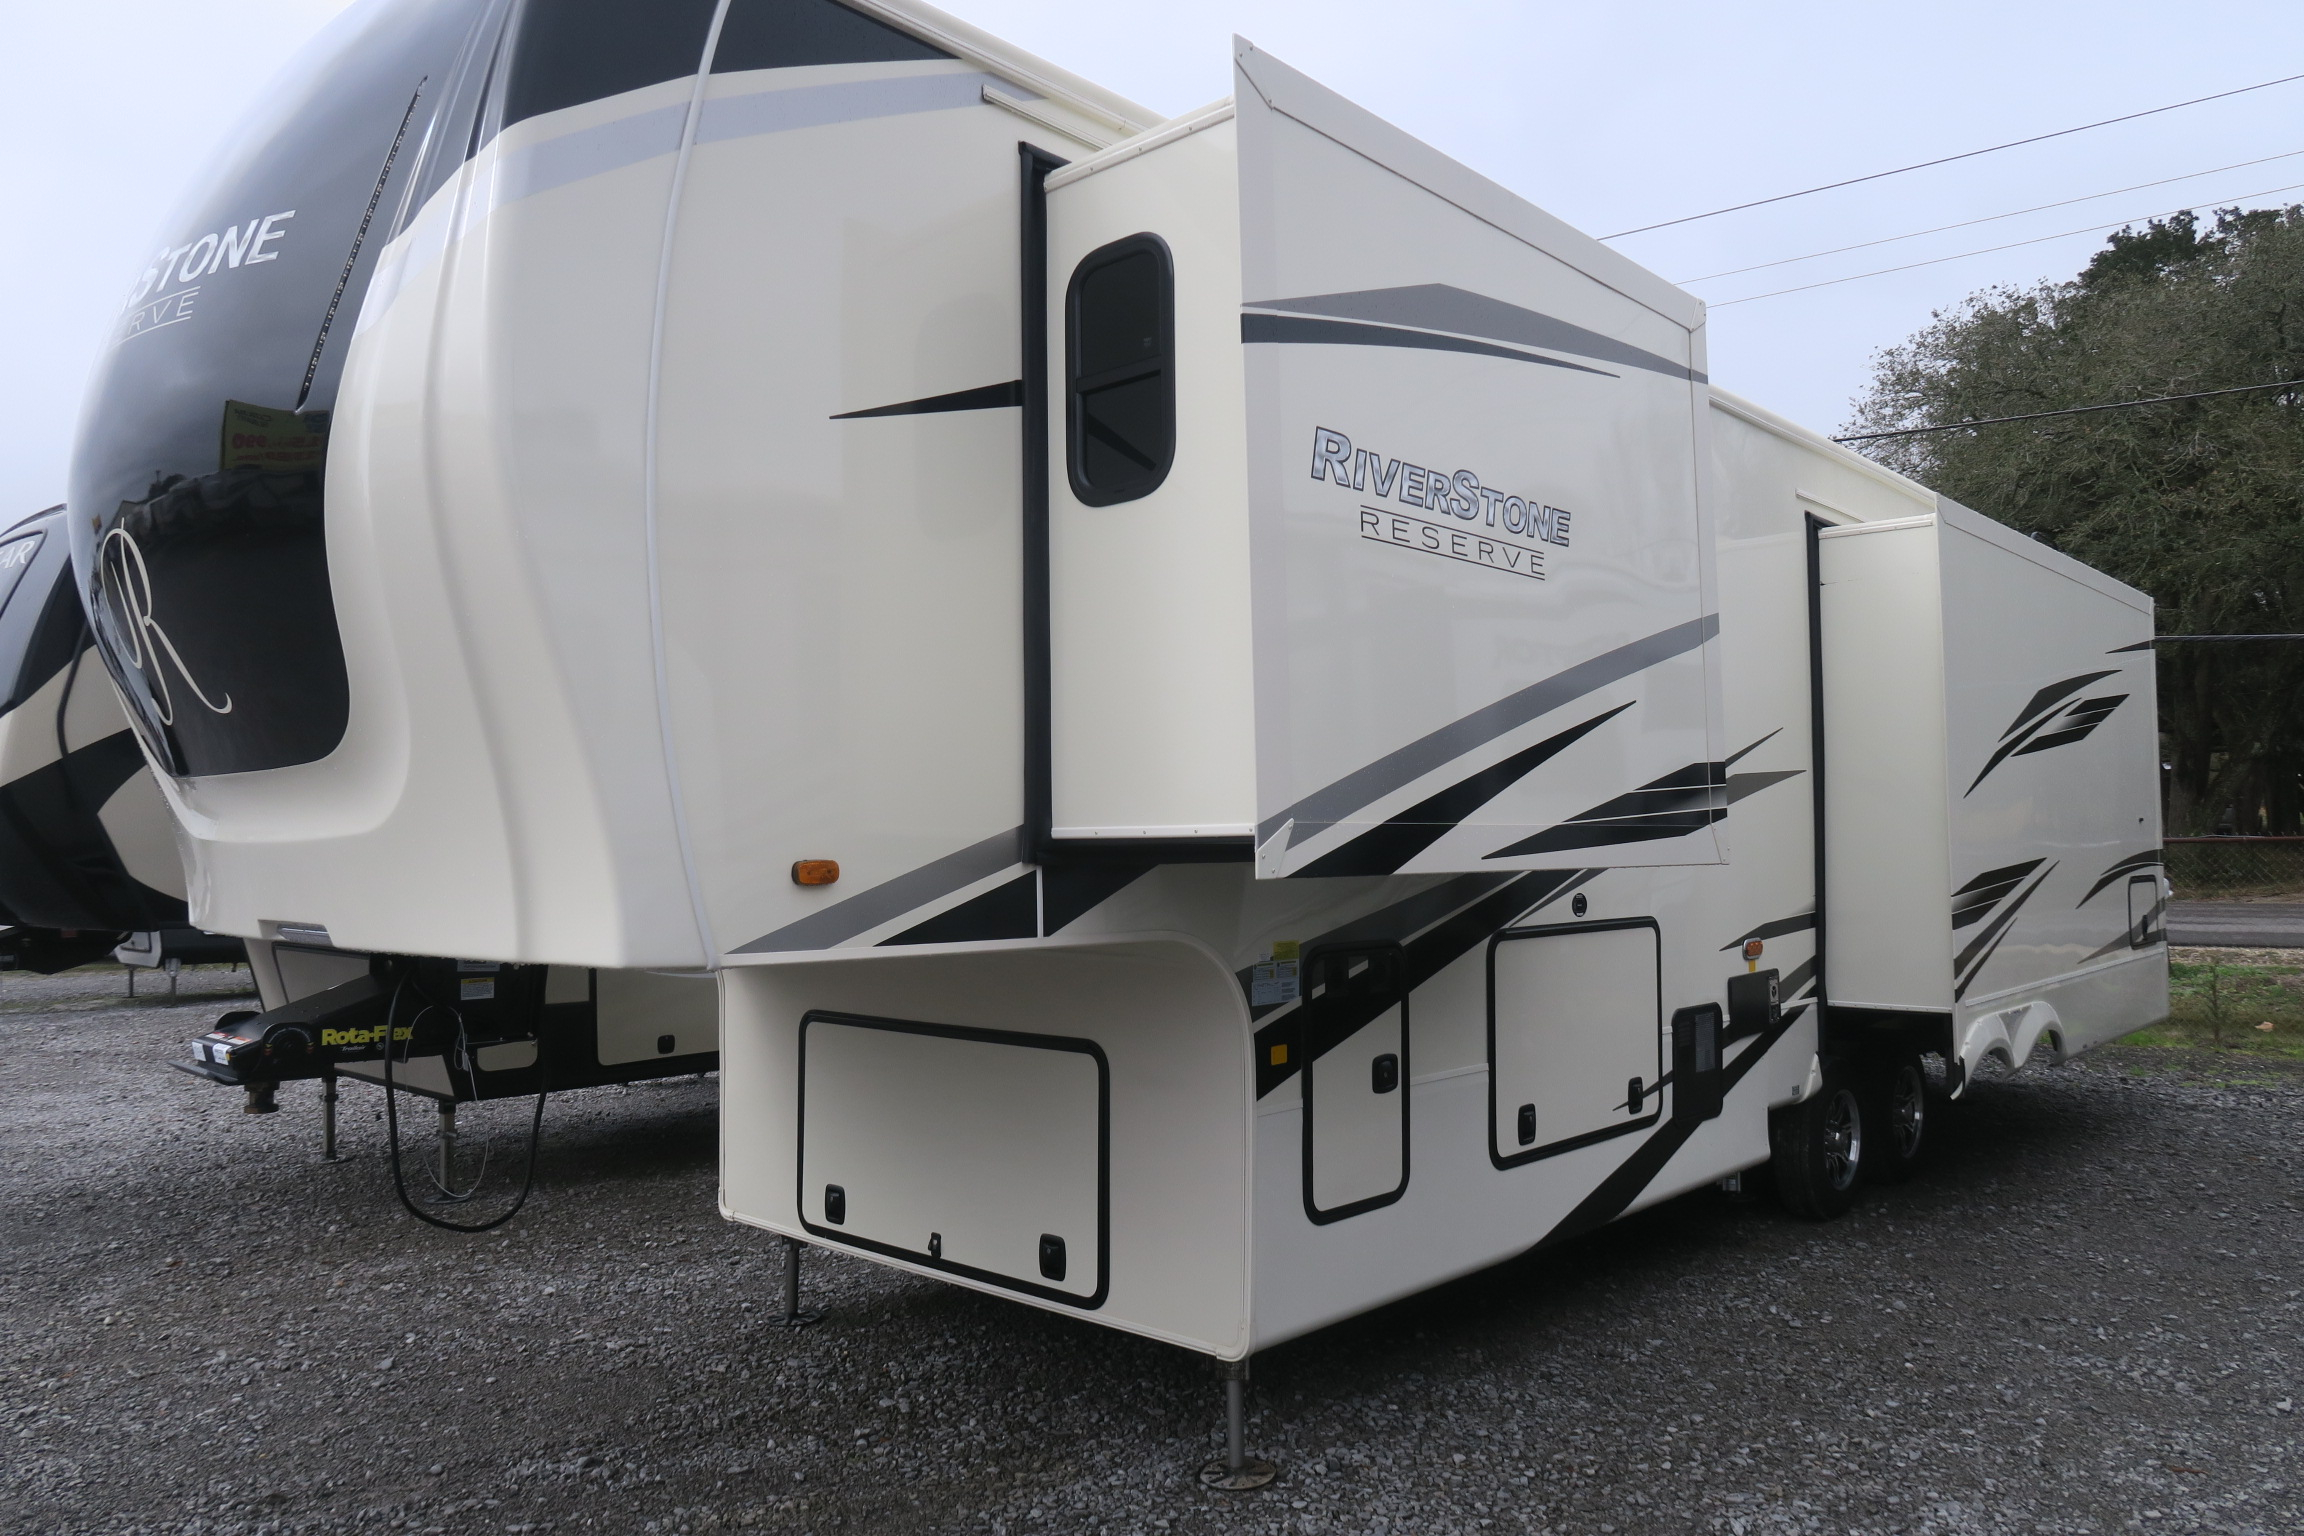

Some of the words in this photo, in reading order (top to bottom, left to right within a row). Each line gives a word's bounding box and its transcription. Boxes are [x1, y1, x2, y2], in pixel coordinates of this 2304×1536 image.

[1310, 425, 1572, 548] RIVERSTONE
[0, 540, 36, 569] AR
[1360, 510, 1545, 576] RESERVE
[321, 1025, 414, 1046] Rota-Fex
